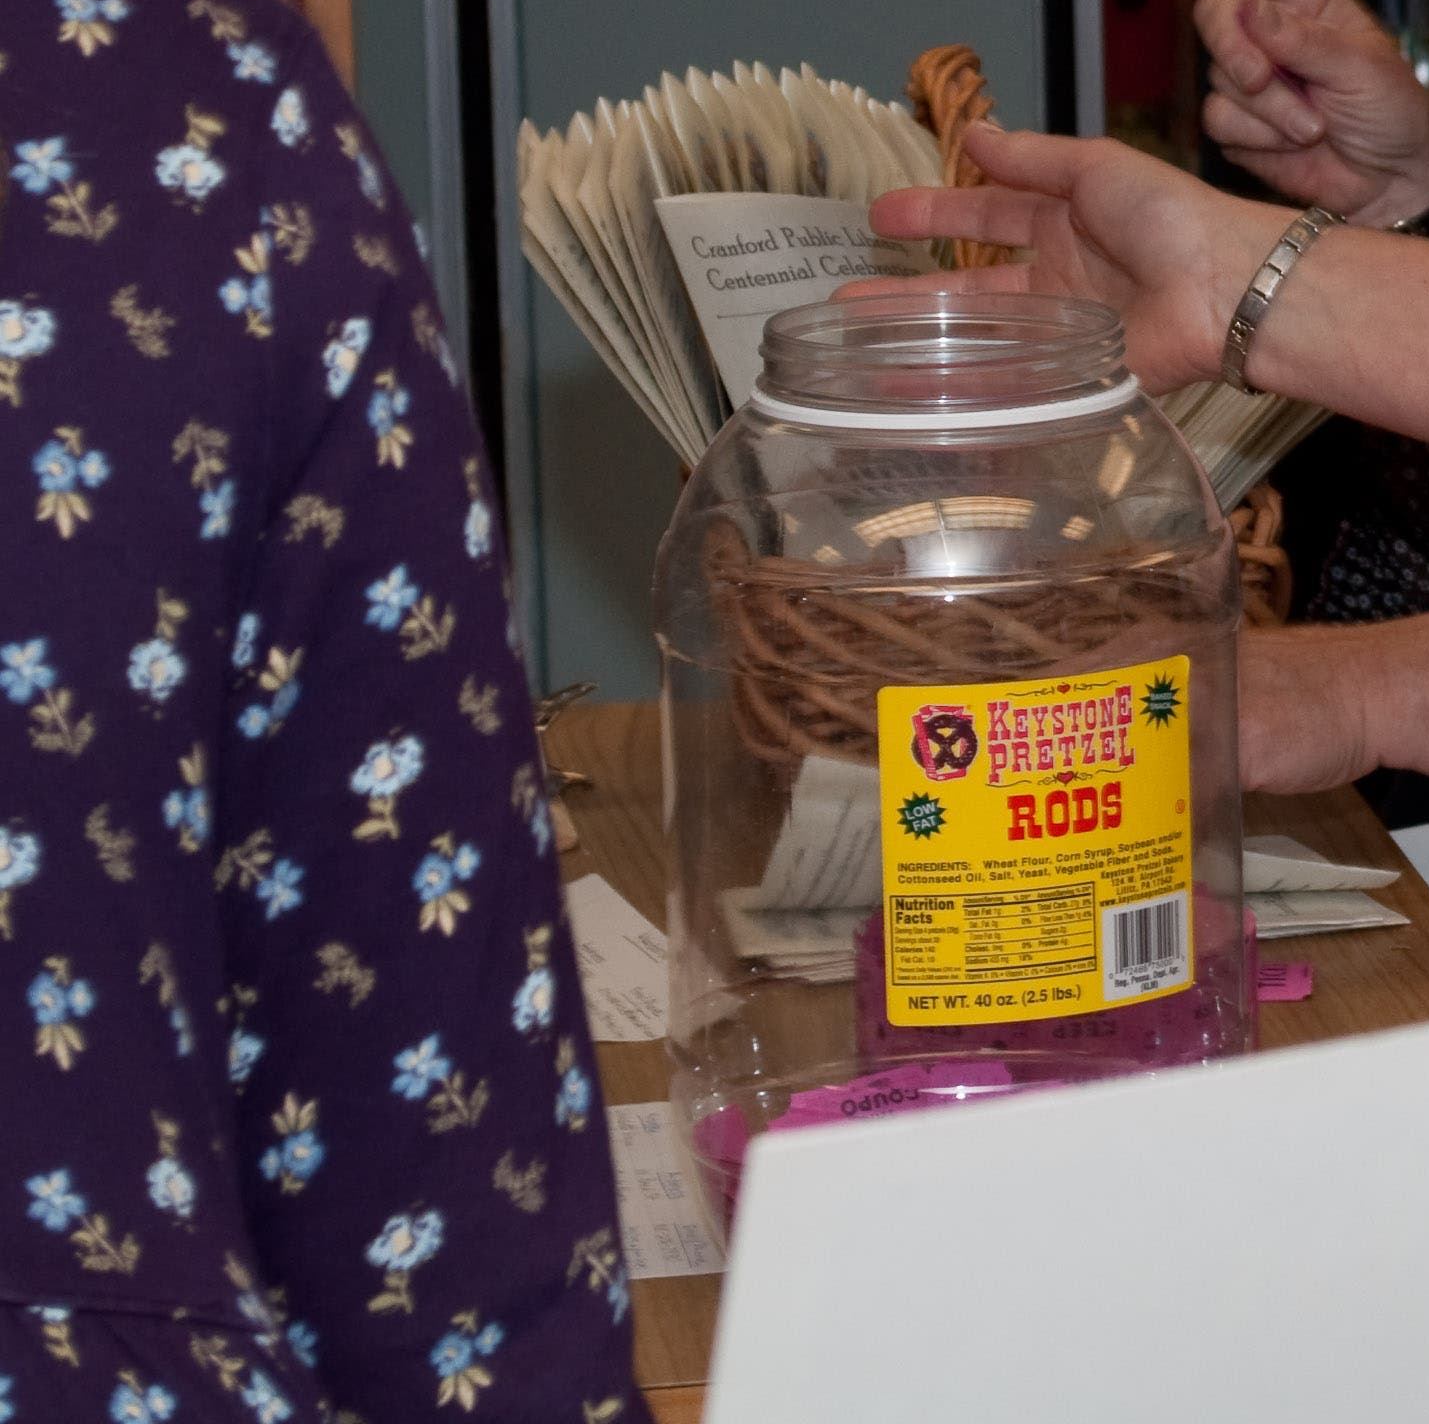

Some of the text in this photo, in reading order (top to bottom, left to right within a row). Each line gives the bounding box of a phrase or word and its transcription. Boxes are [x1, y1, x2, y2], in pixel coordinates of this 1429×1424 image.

[691, 229, 779, 259] Cranford
[780, 227, 842, 248] Public
[706, 258, 816, 291] Centennial
[987, 685, 1134, 741] KEYSTONE
[987, 729, 1135, 784] PRETZEL
[905, 802, 935, 820] LOW
[912, 815, 935, 832] FAT
[1007, 781, 1122, 841] RODS
[898, 862, 971, 872] INGREDIENTS:
[983, 860, 1017, 869] Wheat
[1056, 853, 1080, 862] Corn
[1118, 838, 1155, 852] Soybean
[898, 874, 961, 884] Cottonseed
[966, 873, 985, 882] Oil,
[989, 871, 1014, 881] Salt,
[1055, 860, 1104, 875] Vegetable
[1107, 855, 1130, 866] Fiber
[1133, 852, 1149, 861] and
[895, 898, 954, 910] Nutrition
[896, 912, 933, 924] Facts
[908, 984, 1081, 1010] NET WT. 40 oz. (2.5 lbs.)
